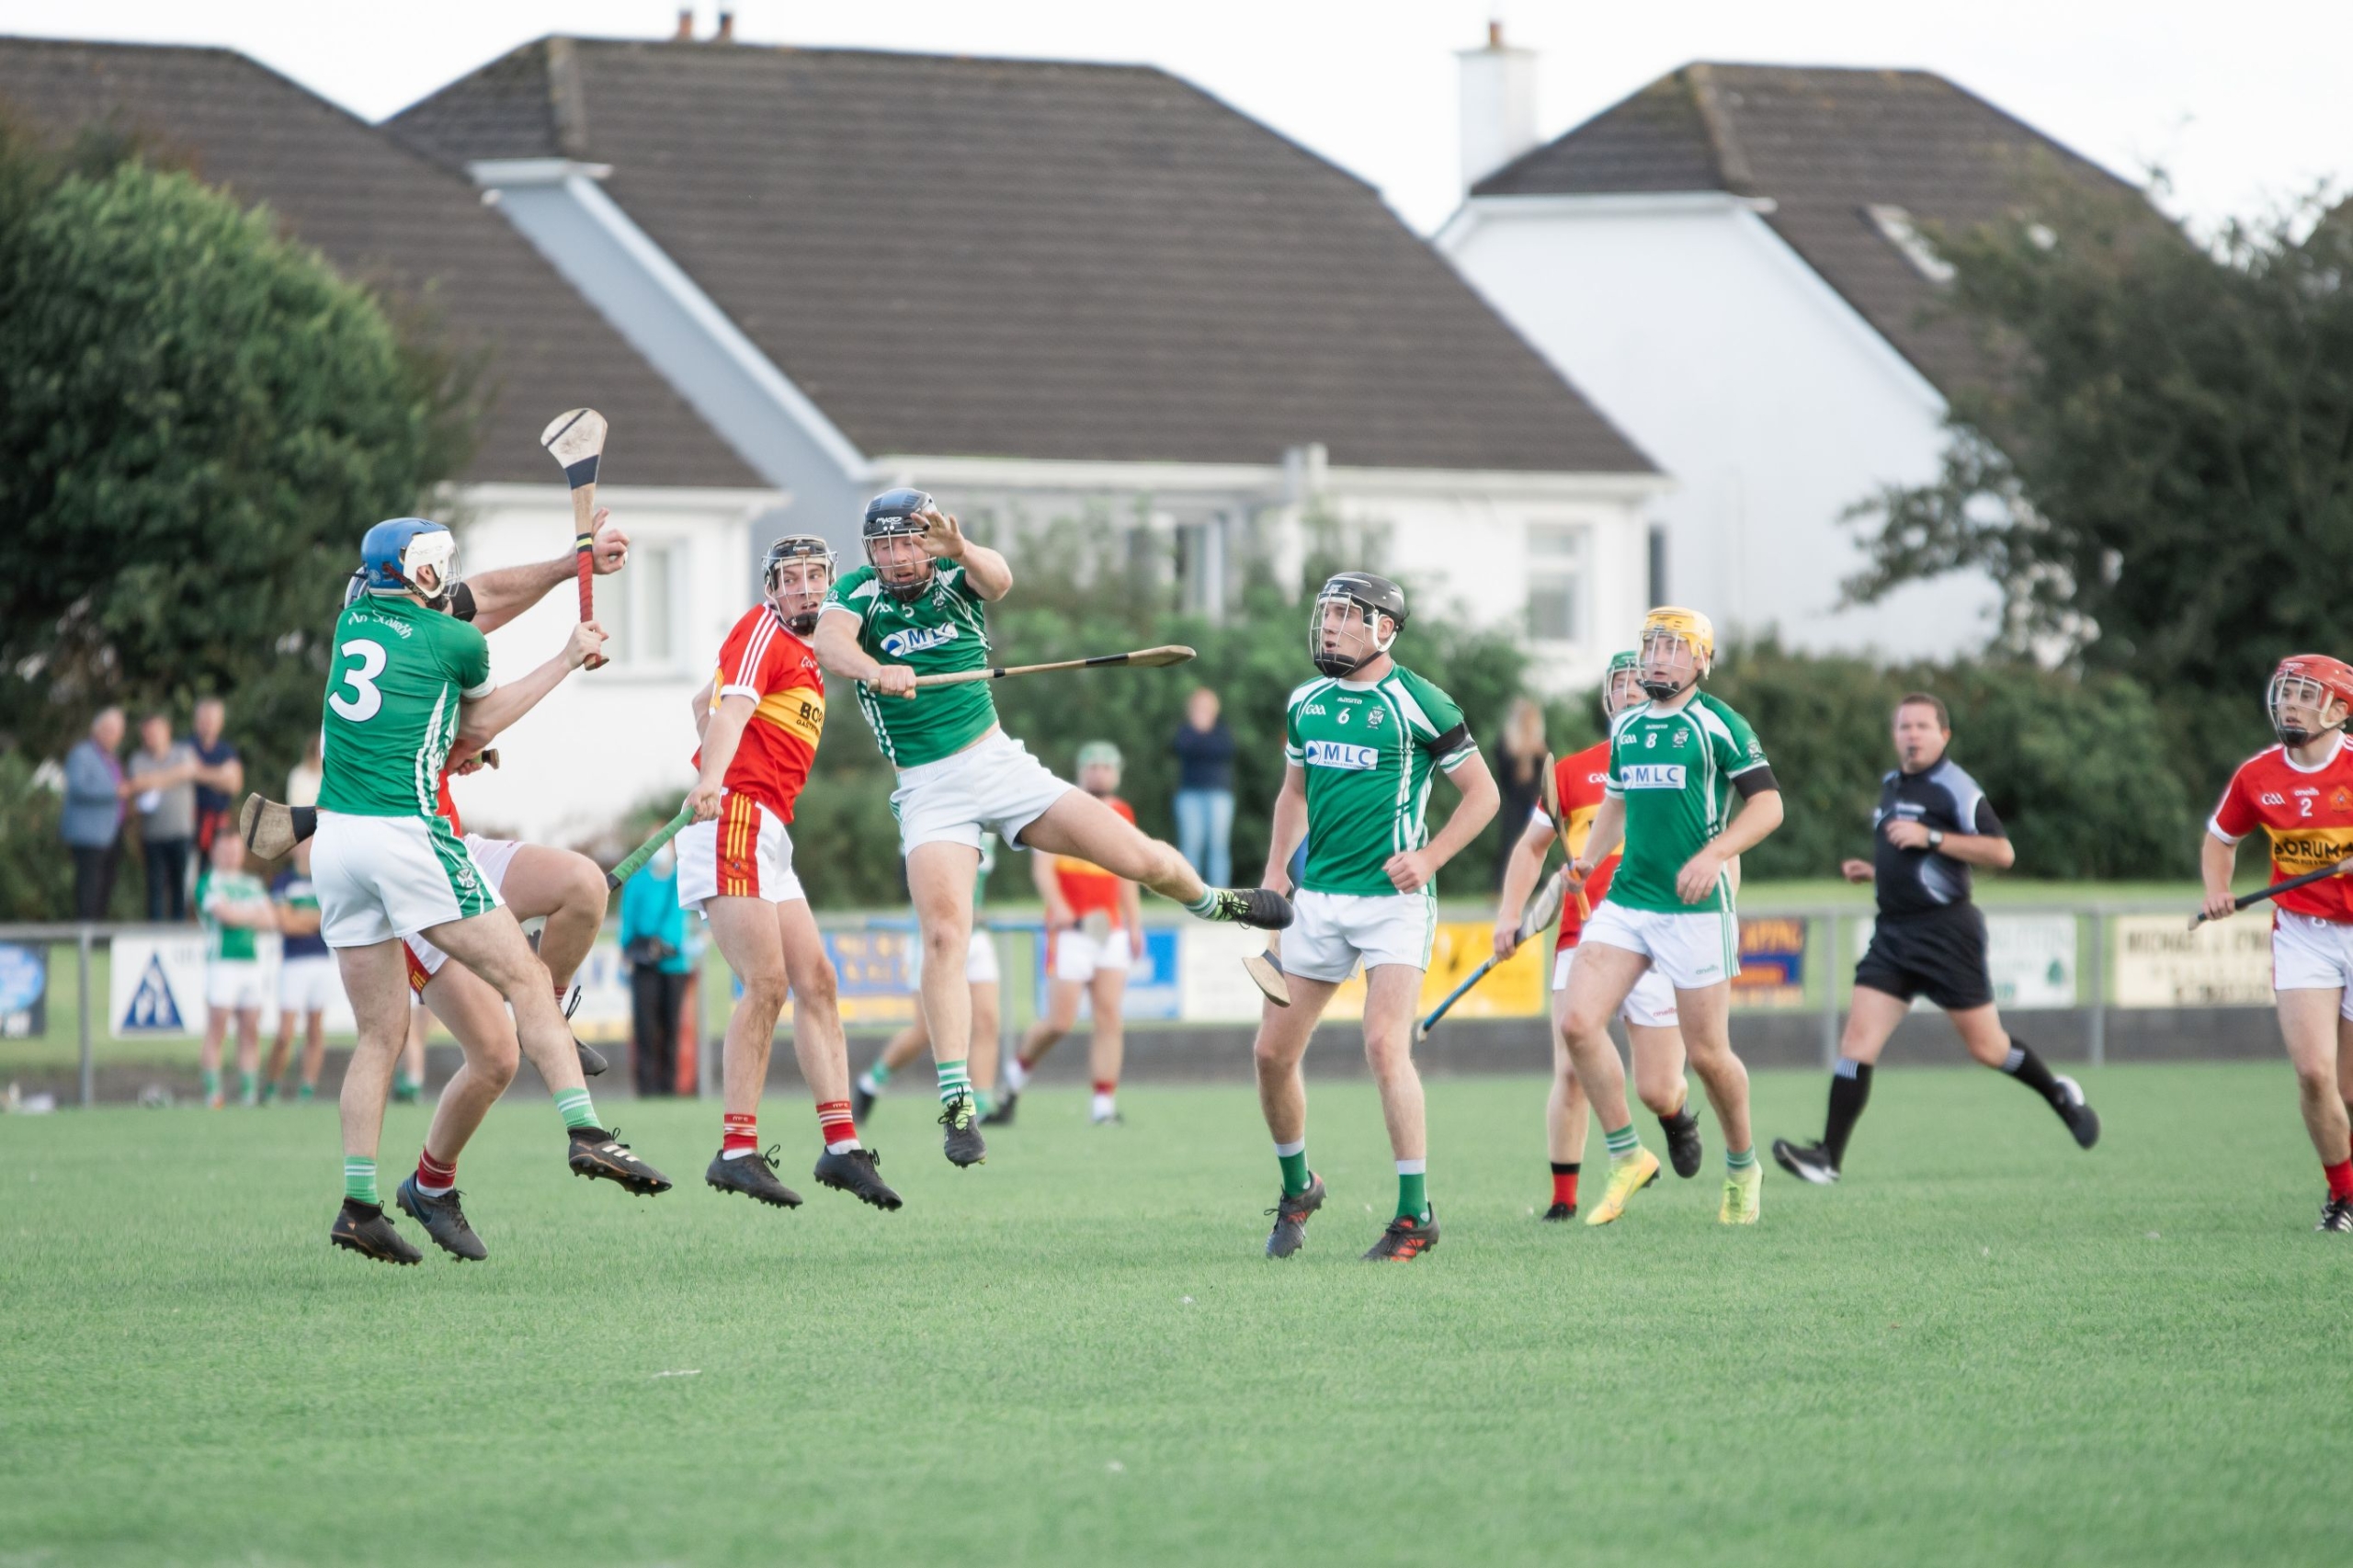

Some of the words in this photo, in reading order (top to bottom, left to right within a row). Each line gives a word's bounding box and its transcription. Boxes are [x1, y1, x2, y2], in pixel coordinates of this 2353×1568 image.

[902, 604, 915, 619] 5
[327, 638, 388, 722] 3
[1305, 704, 1326, 715] GAA
[1337, 708, 1351, 724] 6
[1645, 733, 1657, 748] 8
[1324, 744, 1371, 766] MLC
[1636, 767, 1679, 782] MLC
[2301, 798, 2313, 817] 2
